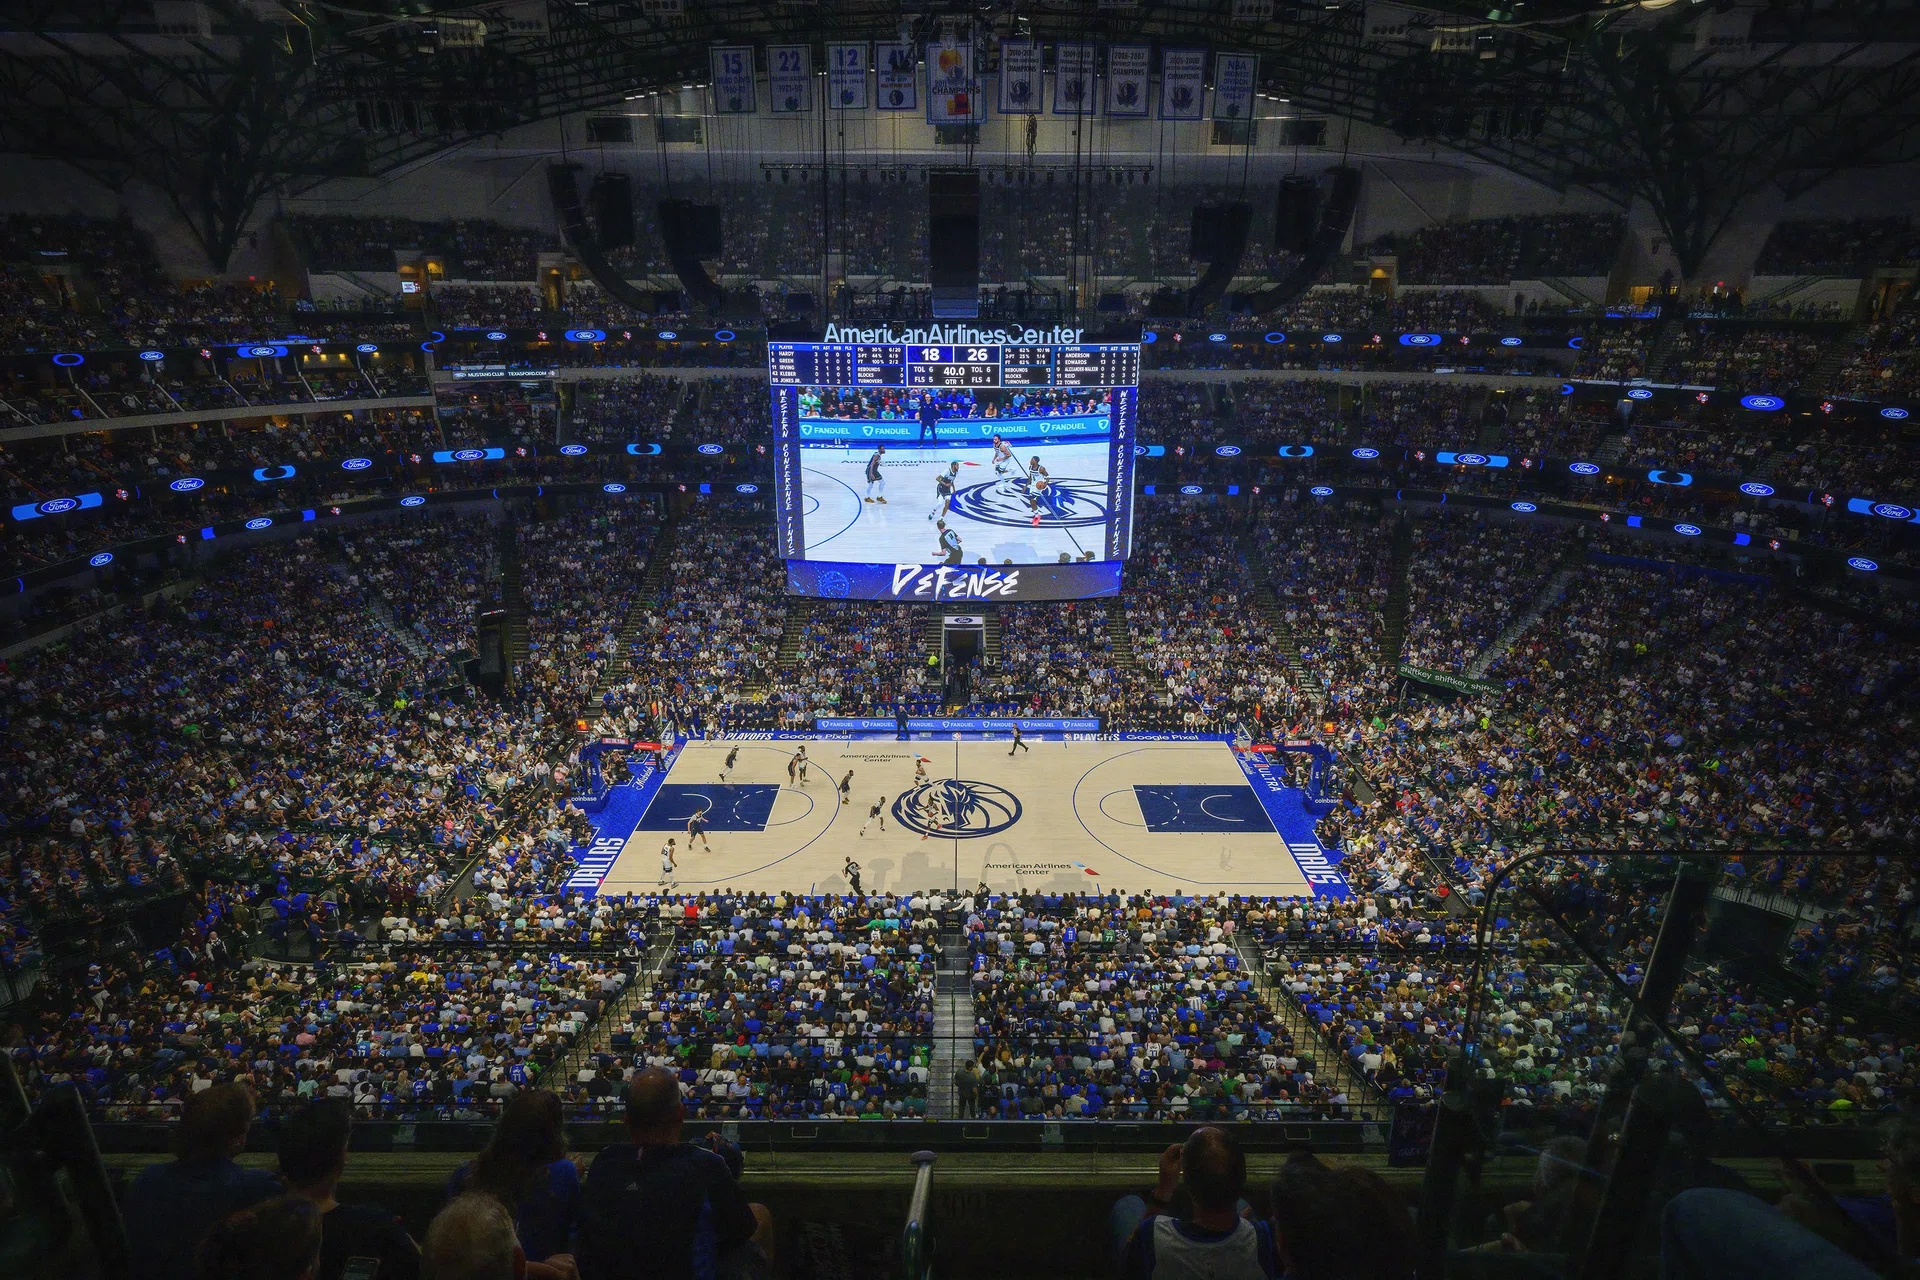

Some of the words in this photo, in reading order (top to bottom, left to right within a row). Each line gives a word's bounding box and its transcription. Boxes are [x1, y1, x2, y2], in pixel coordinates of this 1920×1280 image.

[722, 53, 743, 74] 15
[778, 51, 800, 72] 22
[837, 49, 858, 66] 12
[1113, 68, 1145, 76] CHAMPIONS
[1228, 61, 1246, 70] NBA
[932, 86, 981, 94] CHAMPIONS
[922, 348, 940, 361] 18
[967, 348, 988, 361] 26
[943, 367, 965, 376] 40.0
[779, 389, 789, 439] WESTERN
[1118, 389, 1129, 440] WESTERN
[814, 427, 851, 435] FANDUEL
[874, 427, 911, 435] FANDUEL
[935, 427, 970, 435] FANDUEL
[993, 425, 1028, 434] FANDUEL
[1051, 422, 1086, 431] FANDUEL
[782, 443, 793, 511] CONFERENCE
[1114, 444, 1124, 512] CONFERENCE
[786, 516, 795, 556] FINALS
[1112, 517, 1120, 557] FINALS
[1400, 666, 1432, 680] shiftkey
[1434, 675, 1468, 688] shiftkey
[725, 732, 775, 741] PLAYOFFS
[778, 733, 822, 741] Google
[1126, 734, 1169, 742] Google
[1258, 768, 1282, 792] ULTRA
[566, 837, 625, 887] DALLAS
[1288, 843, 1342, 884] MAVS
[1149, 1049, 1158, 1057] 77
[1265, 1062, 1275, 1070] 14
[512, 1073, 522, 1082] 77
